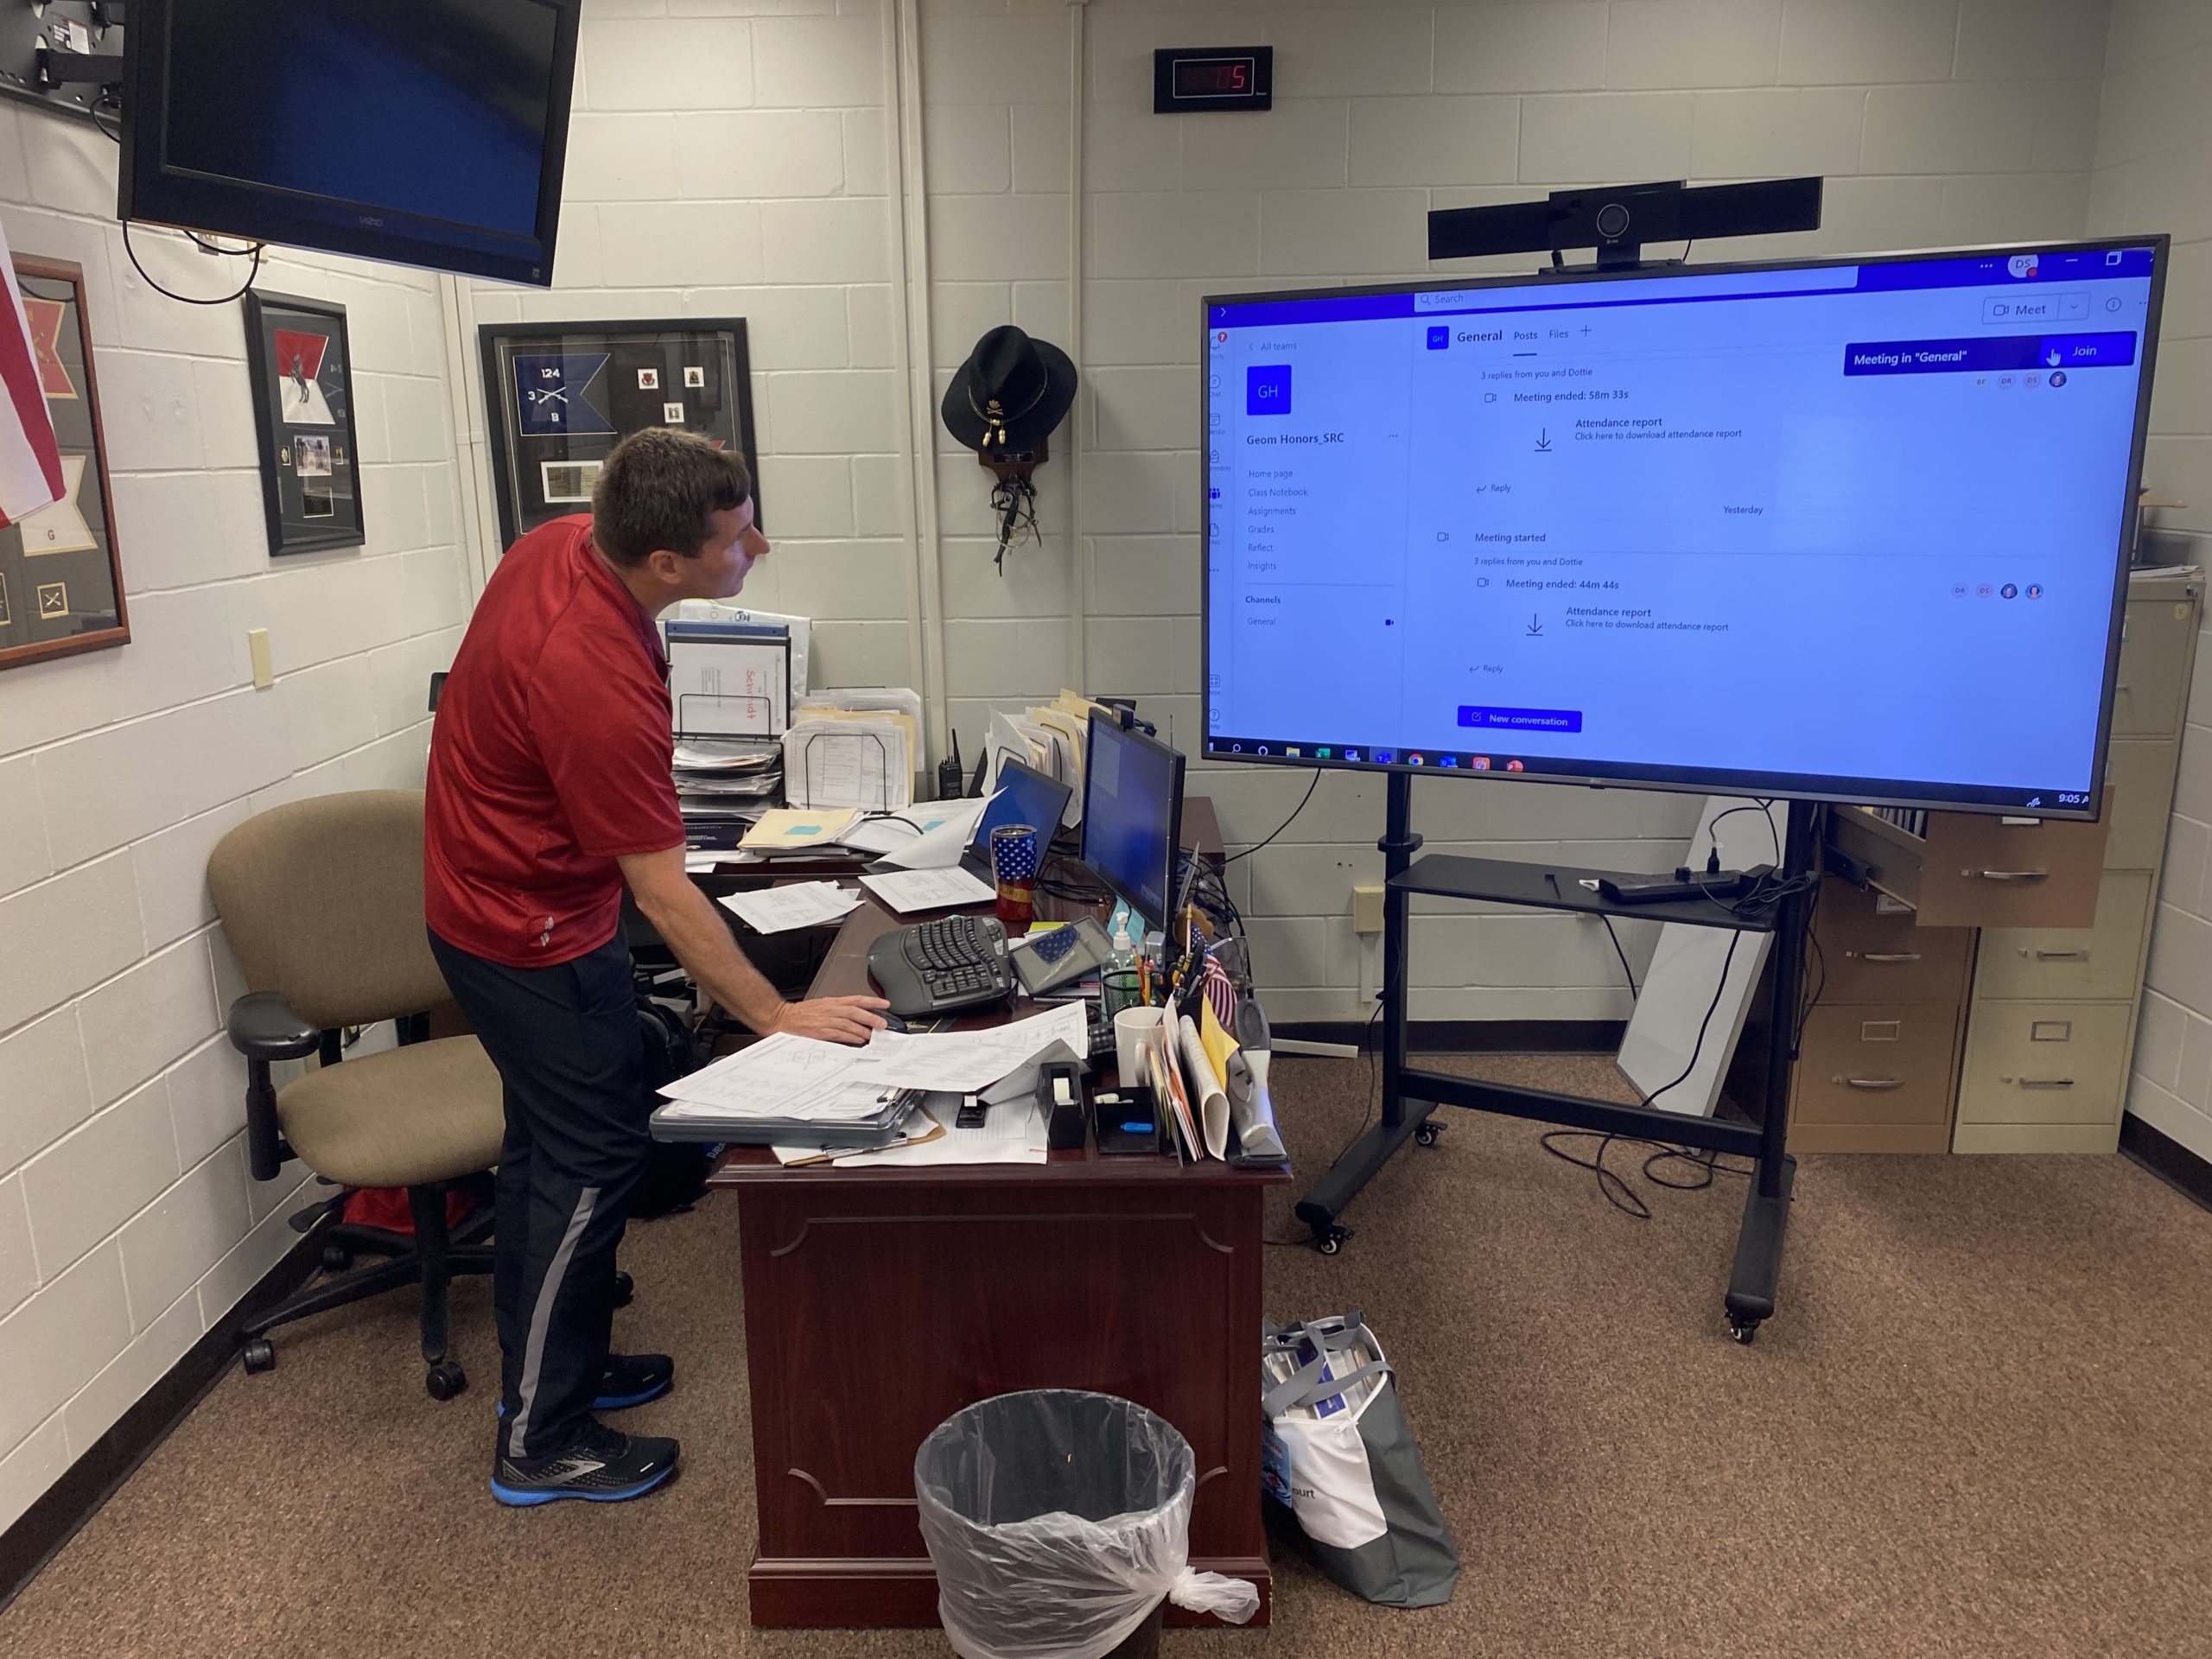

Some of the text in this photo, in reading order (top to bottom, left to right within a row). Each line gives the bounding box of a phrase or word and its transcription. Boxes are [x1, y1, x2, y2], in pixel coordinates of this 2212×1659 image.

[1232, 66, 1245, 88] 5
[2015, 257, 2031, 269] DS
[1434, 294, 1464, 304] Search
[2015, 304, 2046, 315] Meet
[1432, 334, 1443, 343] GH
[1457, 330, 1503, 343] General
[1514, 329, 1538, 341] Posts
[1548, 328, 1569, 340] Files
[1261, 341, 1297, 351] All teams
[2072, 345, 2097, 357] Join
[1853, 350, 1967, 366] Meeting in "General"
[541, 368, 560, 378] 124
[1488, 370, 1513, 380] replies
[1515, 369, 1534, 379] from
[1535, 371, 1549, 379] you
[1551, 368, 1567, 378] and
[1568, 367, 1593, 377] Dottie
[527, 391, 536, 401] 3
[1257, 385, 1279, 398] GH
[1514, 389, 1629, 404] Meeting ended: 58m 33s
[550, 413, 559, 422] B
[1575, 416, 1662, 429] Attendance report
[1247, 432, 1344, 445] Geom Honors_SRC
[1574, 429, 1742, 441] Click here to download attendance report
[1249, 469, 1294, 480] Home page
[1249, 487, 1308, 497] Class Notebook
[1491, 483, 1511, 494] Reply
[1249, 505, 1296, 517] Assignments
[1723, 505, 1764, 517] Yesterday
[1248, 524, 1274, 533] Grades
[48, 529, 55, 541] G
[1475, 532, 1546, 545] Meeting started
[1248, 543, 1274, 552] Reflect
[1248, 562, 1277, 572] Insights
[1473, 556, 1583, 569] 3 replies from you and Dottie
[1506, 579, 1619, 590] Meeting ended: 44m 44s
[1245, 595, 1281, 605] Channels
[1566, 607, 1651, 620] Attendance report
[1247, 617, 1276, 626] General
[1566, 619, 1729, 632] Click here to download attendance report
[1483, 664, 1503, 675] Reply
[1489, 714, 1568, 728] New conversation
[2058, 793, 2081, 804] 9:05
